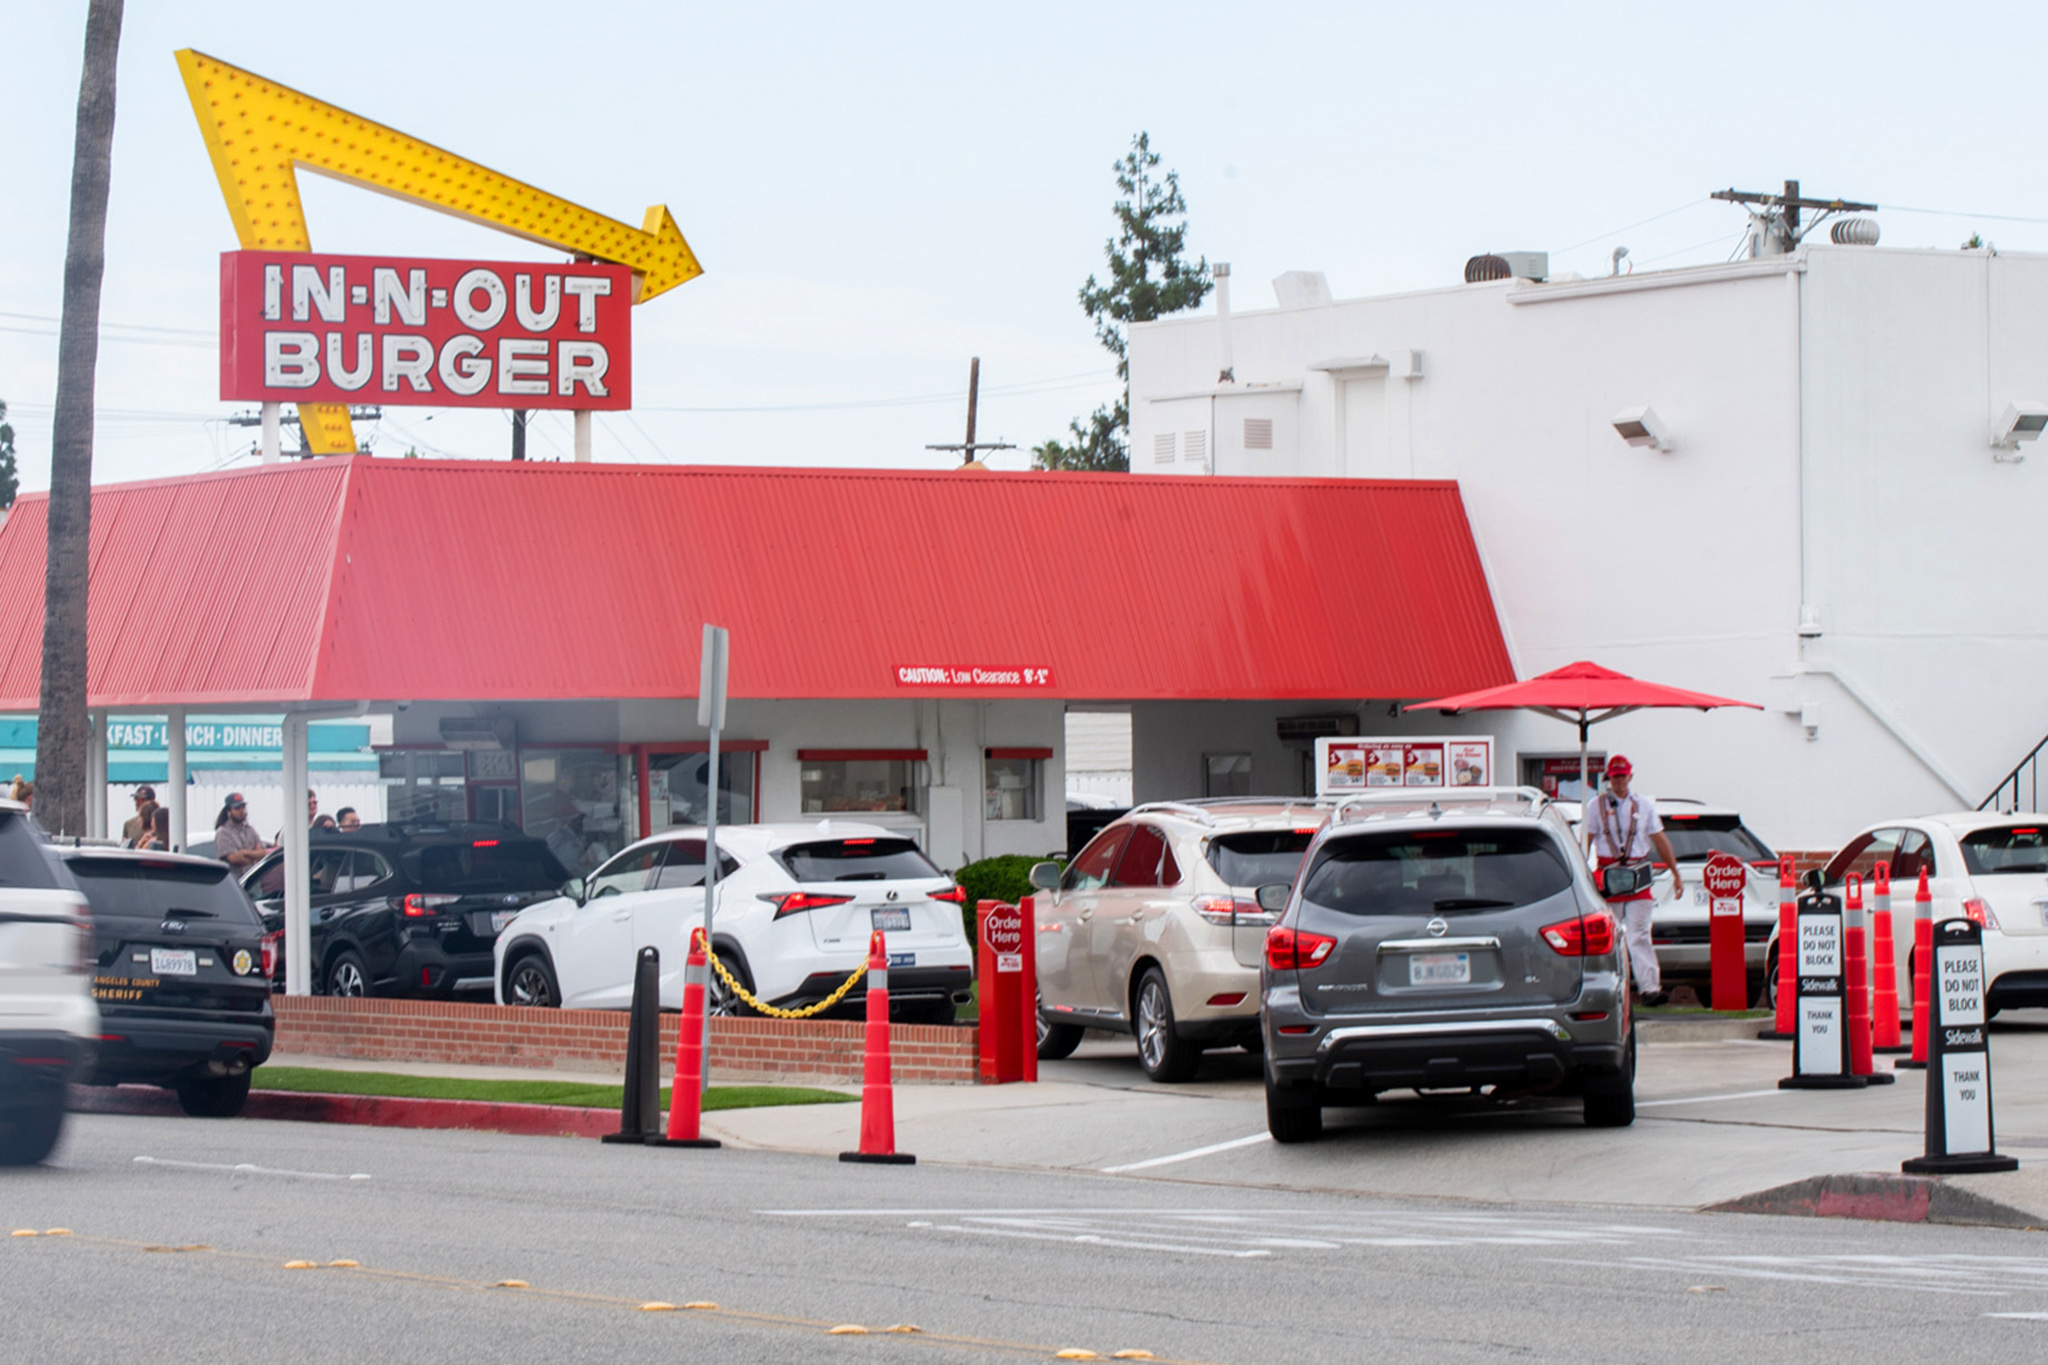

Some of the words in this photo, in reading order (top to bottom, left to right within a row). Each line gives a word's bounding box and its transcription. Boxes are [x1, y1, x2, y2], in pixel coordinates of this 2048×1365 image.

[263, 264, 612, 333] IN-N-OUT
[263, 331, 611, 397] BURGER
[899, 667, 950, 684] CAUTION:
[951, 668, 971, 683] Low
[972, 668, 1020, 684] Clearance
[160, 725, 214, 746] LNCH
[1706, 864, 1743, 877] Order
[1710, 878, 1741, 890] Here
[988, 915, 1021, 930] Order
[992, 930, 1021, 943] Here
[1803, 925, 1835, 936] PLEASE
[1803, 940, 1816, 951] DO
[1818, 940, 1836, 950] NOT
[1805, 954, 1834, 965] BLOCK
[1944, 959, 1978, 974] PLEASE
[93, 976, 129, 986] ANGELES
[131, 977, 160, 988] COUNTY
[1801, 978, 1838, 992] Sidewalk
[1945, 979, 1959, 993] DO
[1962, 978, 1979, 992] NOT
[91, 988, 143, 1000] SHERIFF
[1949, 997, 1978, 1011] BLOCK
[1807, 1010, 1833, 1020] THANK
[1811, 1024, 1828, 1034] YOU
[1944, 1028, 1983, 1045] Sidewalk
[1953, 1071, 1980, 1083] THANK
[1960, 1089, 1976, 1101] YOU
